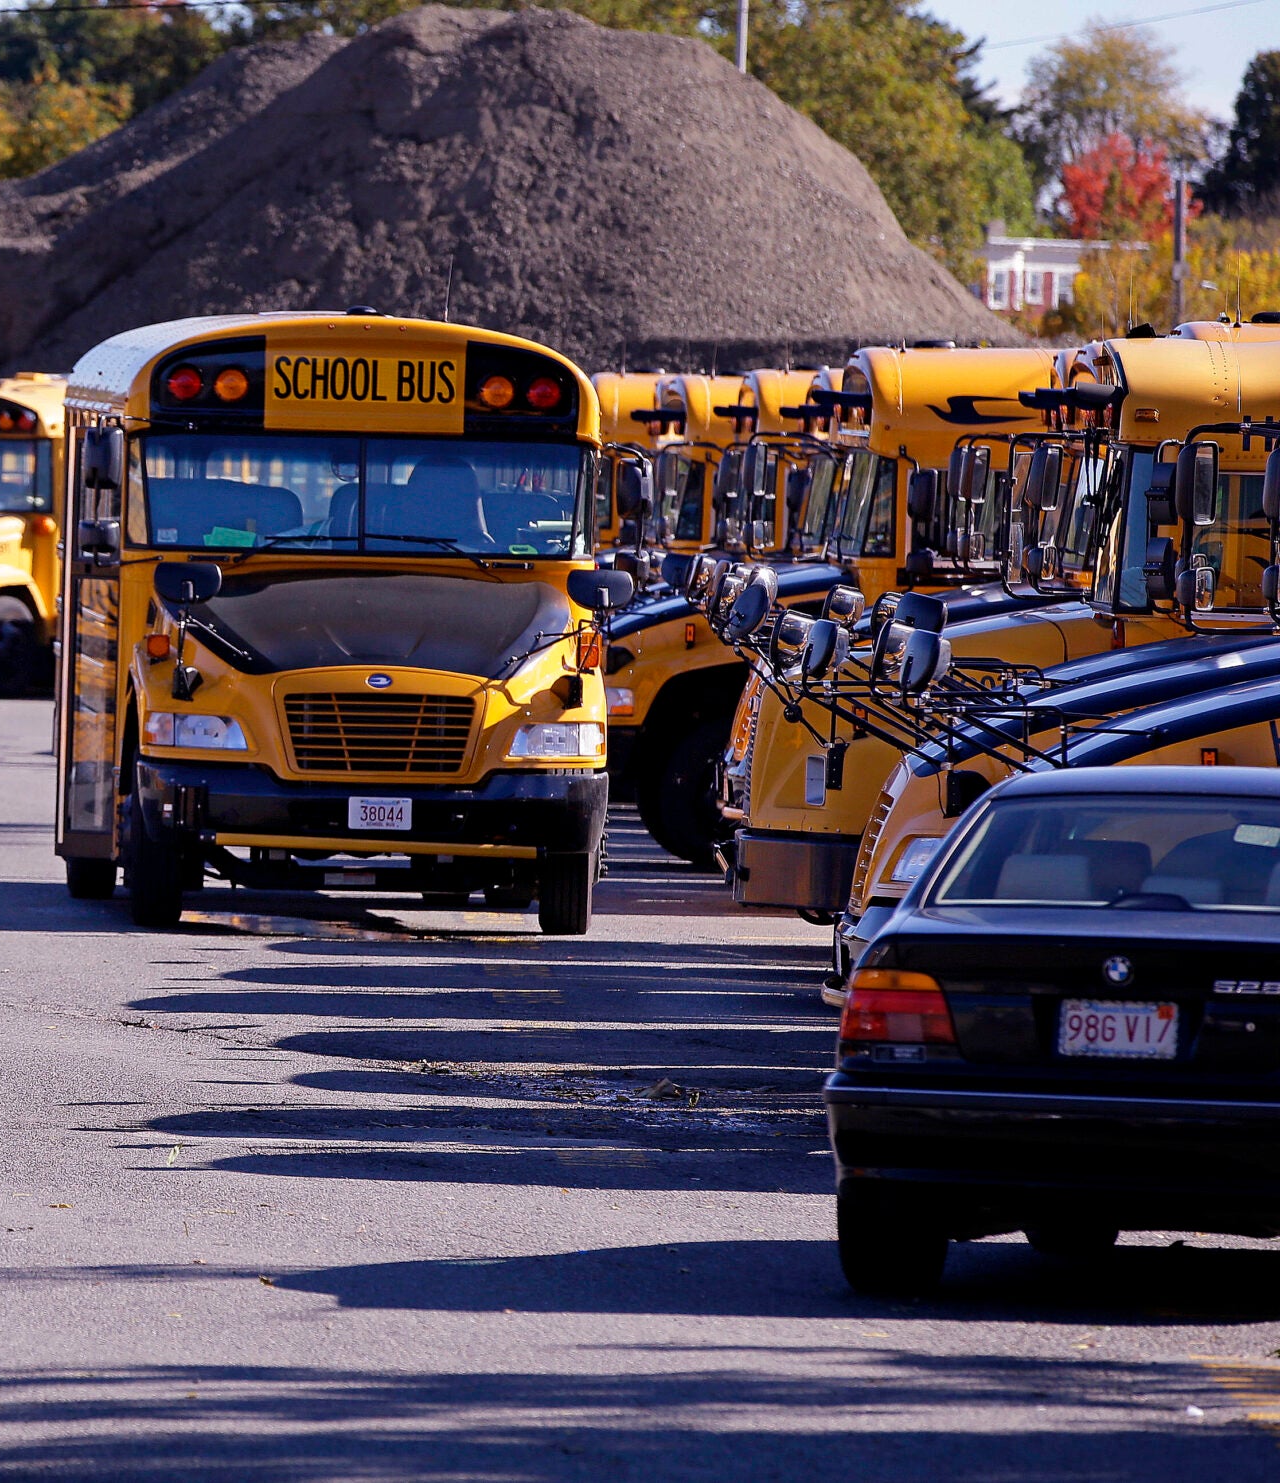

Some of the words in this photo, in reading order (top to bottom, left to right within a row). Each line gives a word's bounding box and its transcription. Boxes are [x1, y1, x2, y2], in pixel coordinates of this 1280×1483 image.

[273, 356, 387, 401] SCHOOL
[397, 360, 456, 404] BUS
[360, 805, 403, 822] 38044
